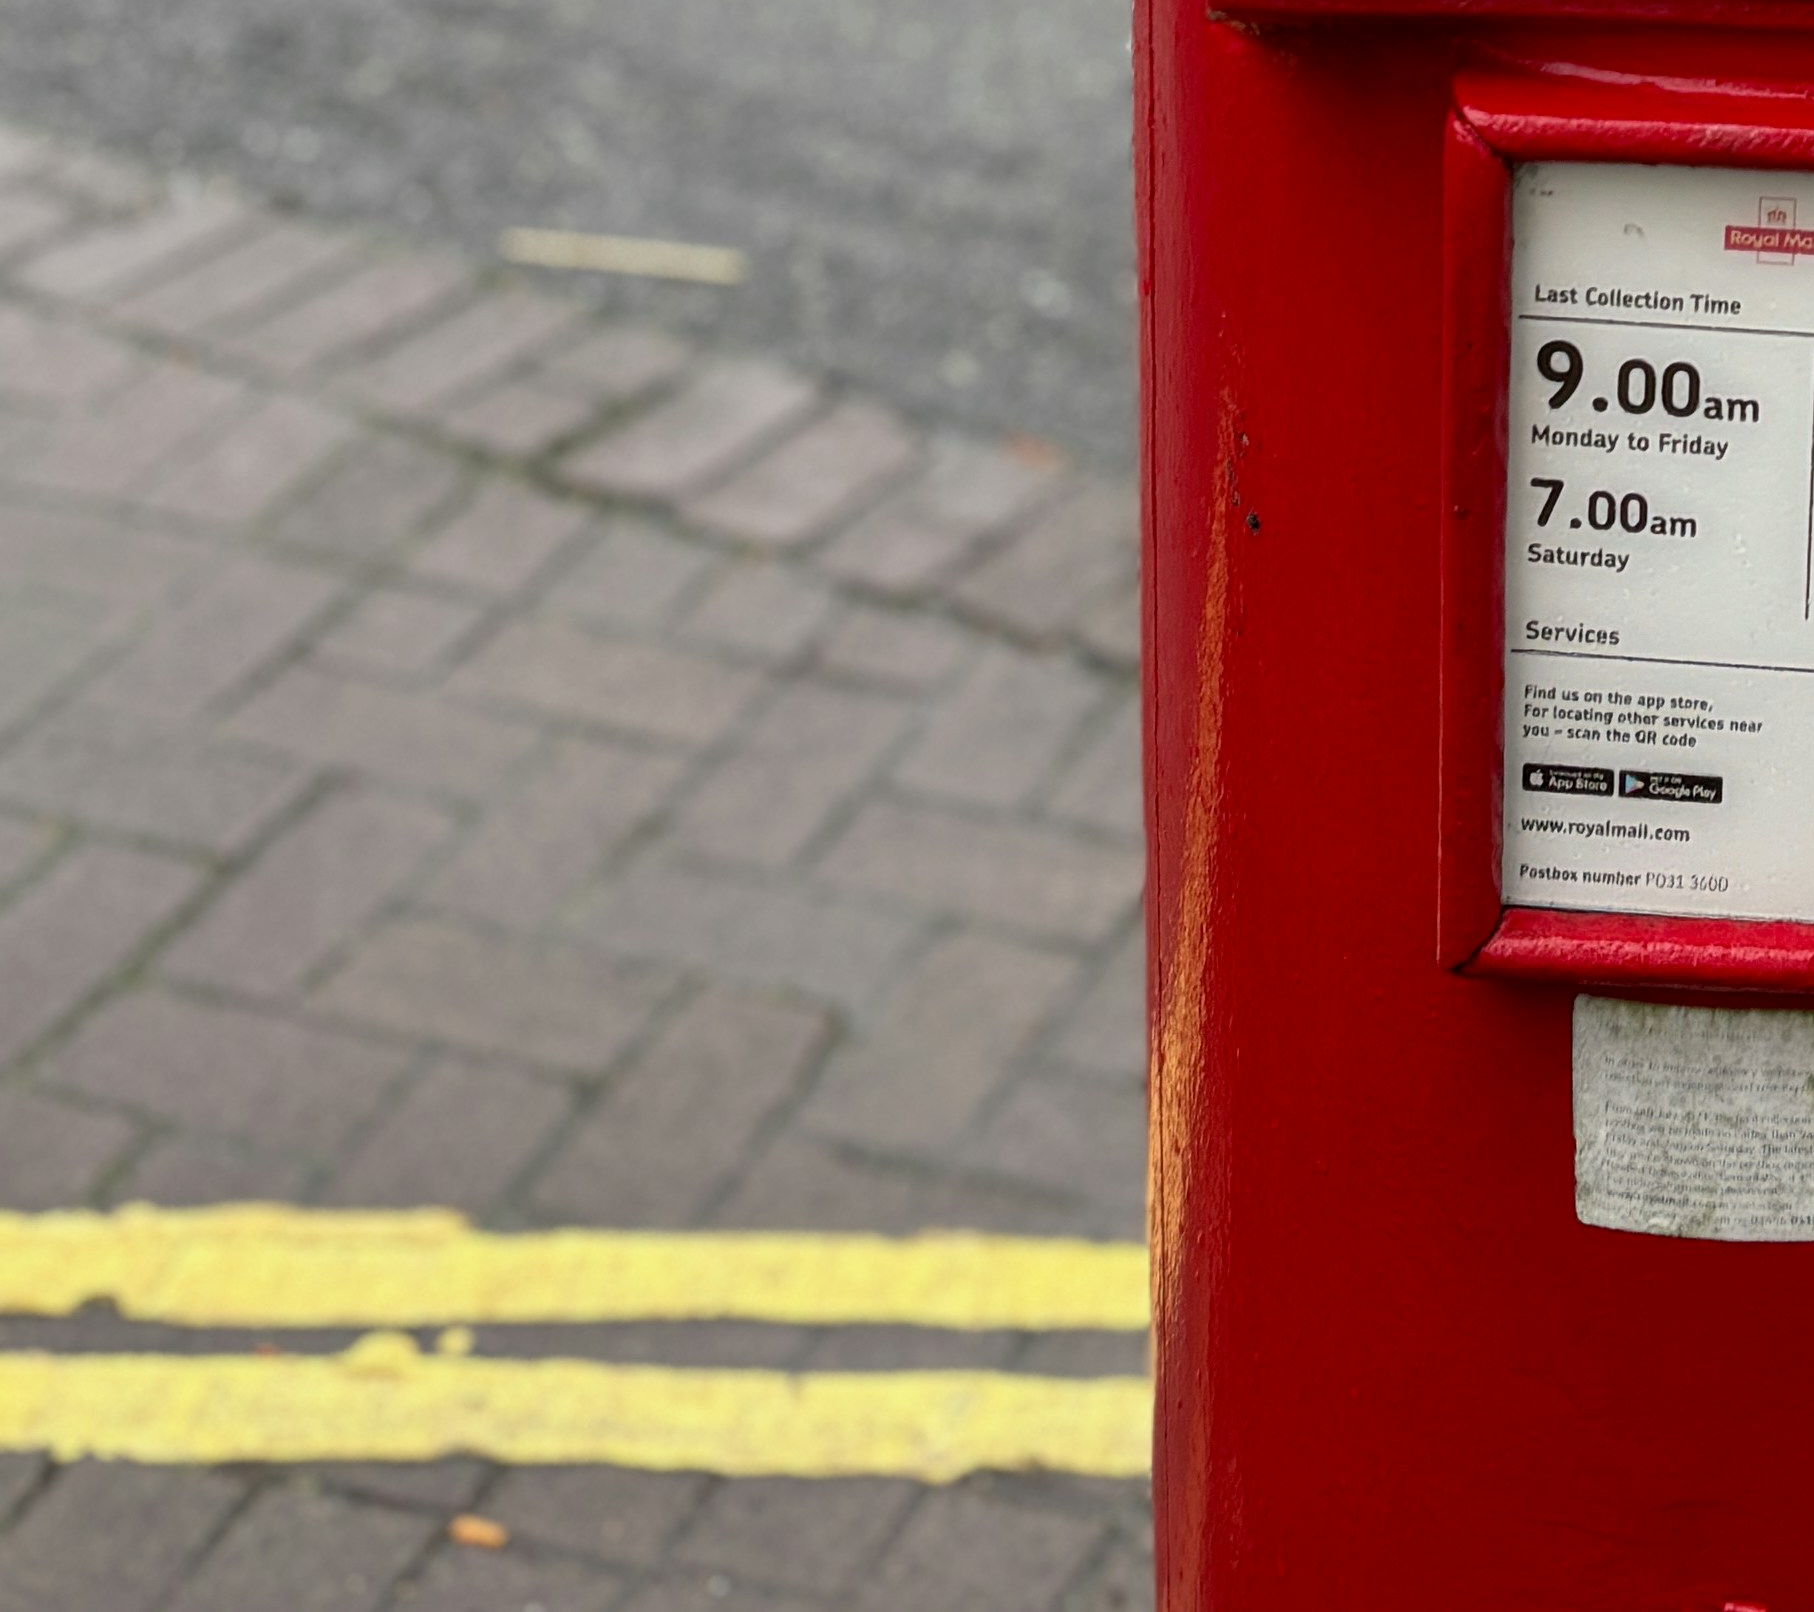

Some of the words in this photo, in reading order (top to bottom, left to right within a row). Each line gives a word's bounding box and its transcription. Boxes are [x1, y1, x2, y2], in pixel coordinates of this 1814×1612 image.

[1730, 229, 1779, 249] Royal
[1534, 284, 1578, 305] Last
[1585, 286, 1684, 312] Collection
[1690, 294, 1742, 315] Time
[1537, 340, 1760, 423] 9.00am
[1531, 424, 1620, 453] Monday
[1628, 432, 1650, 452] to
[1659, 433, 1729, 460] Friday
[1530, 477, 1697, 538] 7.00am
[1527, 542, 1630, 573] Saturday
[1525, 619, 1620, 646] Services
[1524, 683, 1557, 701] Find
[1562, 689, 1579, 703] us
[1584, 690, 1603, 704] on
[1607, 691, 1633, 706] the
[1637, 694, 1666, 711] app
[1670, 696, 1714, 713] store,
[1523, 703, 1550, 719] For
[1553, 704, 1614, 726] locating
[1617, 711, 1659, 727] other
[1663, 714, 1725, 732] services
[1729, 719, 1764, 734] near
[1522, 724, 1550, 739] you
[1566, 729, 1601, 742] scan
[1606, 729, 1631, 744] the
[1635, 730, 1657, 746] QR
[1662, 733, 1698, 749] code
[1549, 776, 1574, 791] App
[1575, 778, 1608, 792] Store
[1649, 782, 1691, 798] Google
[1693, 785, 1717, 801] Play
[1520, 816, 1691, 843] www.royalmail.com
[1519, 862, 1578, 883] Postbox
[1582, 869, 1641, 887] number
